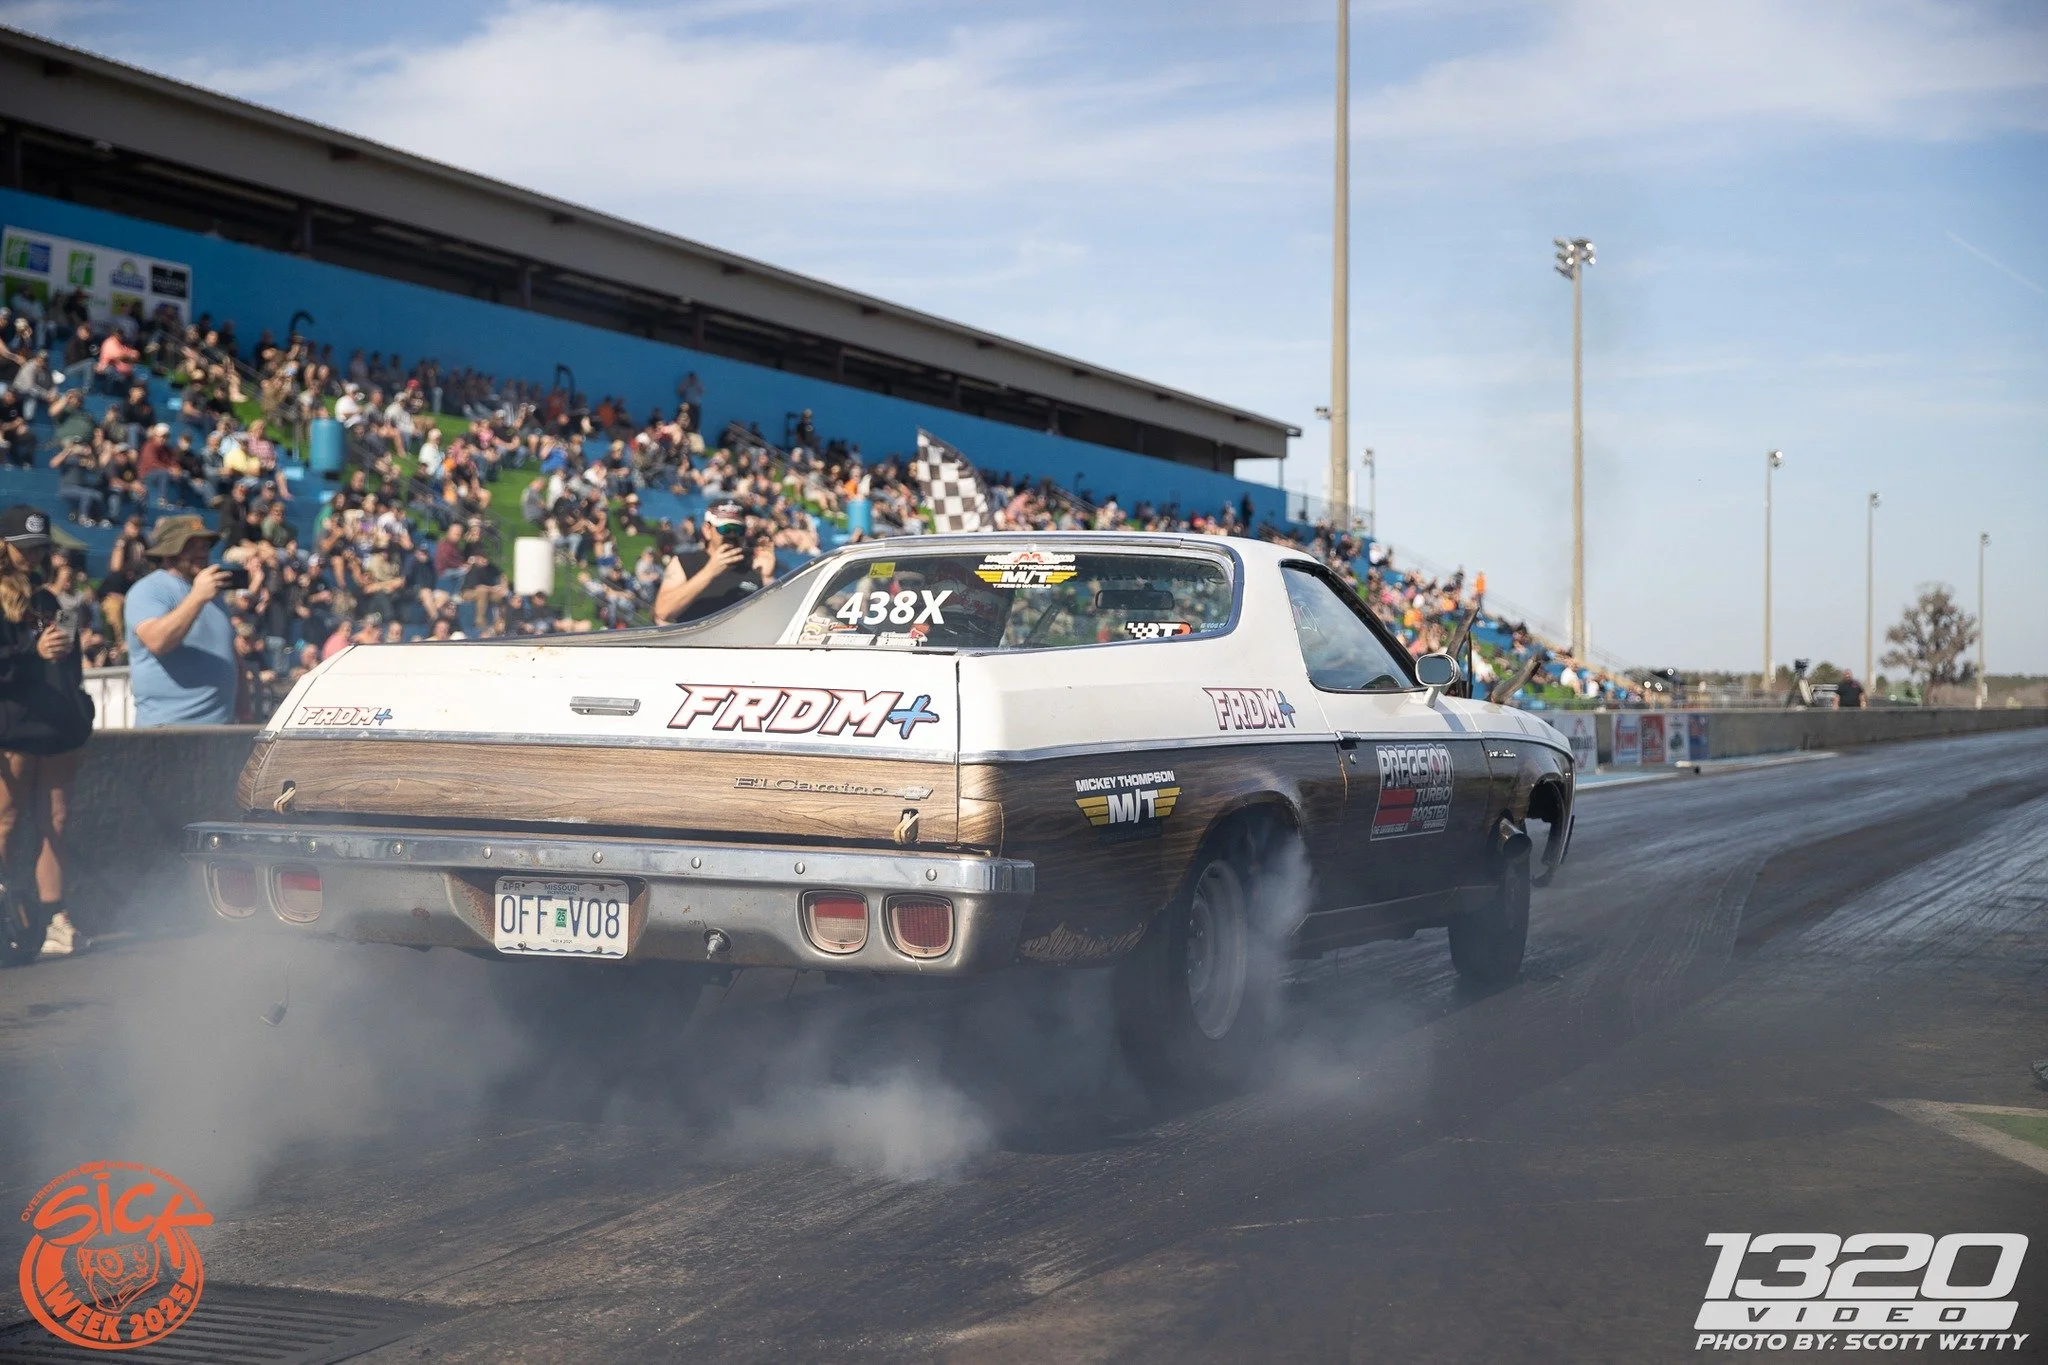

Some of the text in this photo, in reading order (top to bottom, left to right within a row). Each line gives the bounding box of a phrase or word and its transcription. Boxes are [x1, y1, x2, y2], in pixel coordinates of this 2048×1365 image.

[1001, 571, 1054, 584] M/T
[836, 590, 954, 625] 438X
[735, 777, 888, 794] El Camino
[1075, 770, 1176, 793] MICKEY THOMPSON
[1415, 787, 1450, 803] TURBO
[1107, 788, 1160, 824] M/T
[1411, 805, 1447, 822] BOOSTED
[544, 883, 580, 892] MISSOURI
[557, 911, 566, 922] 25
